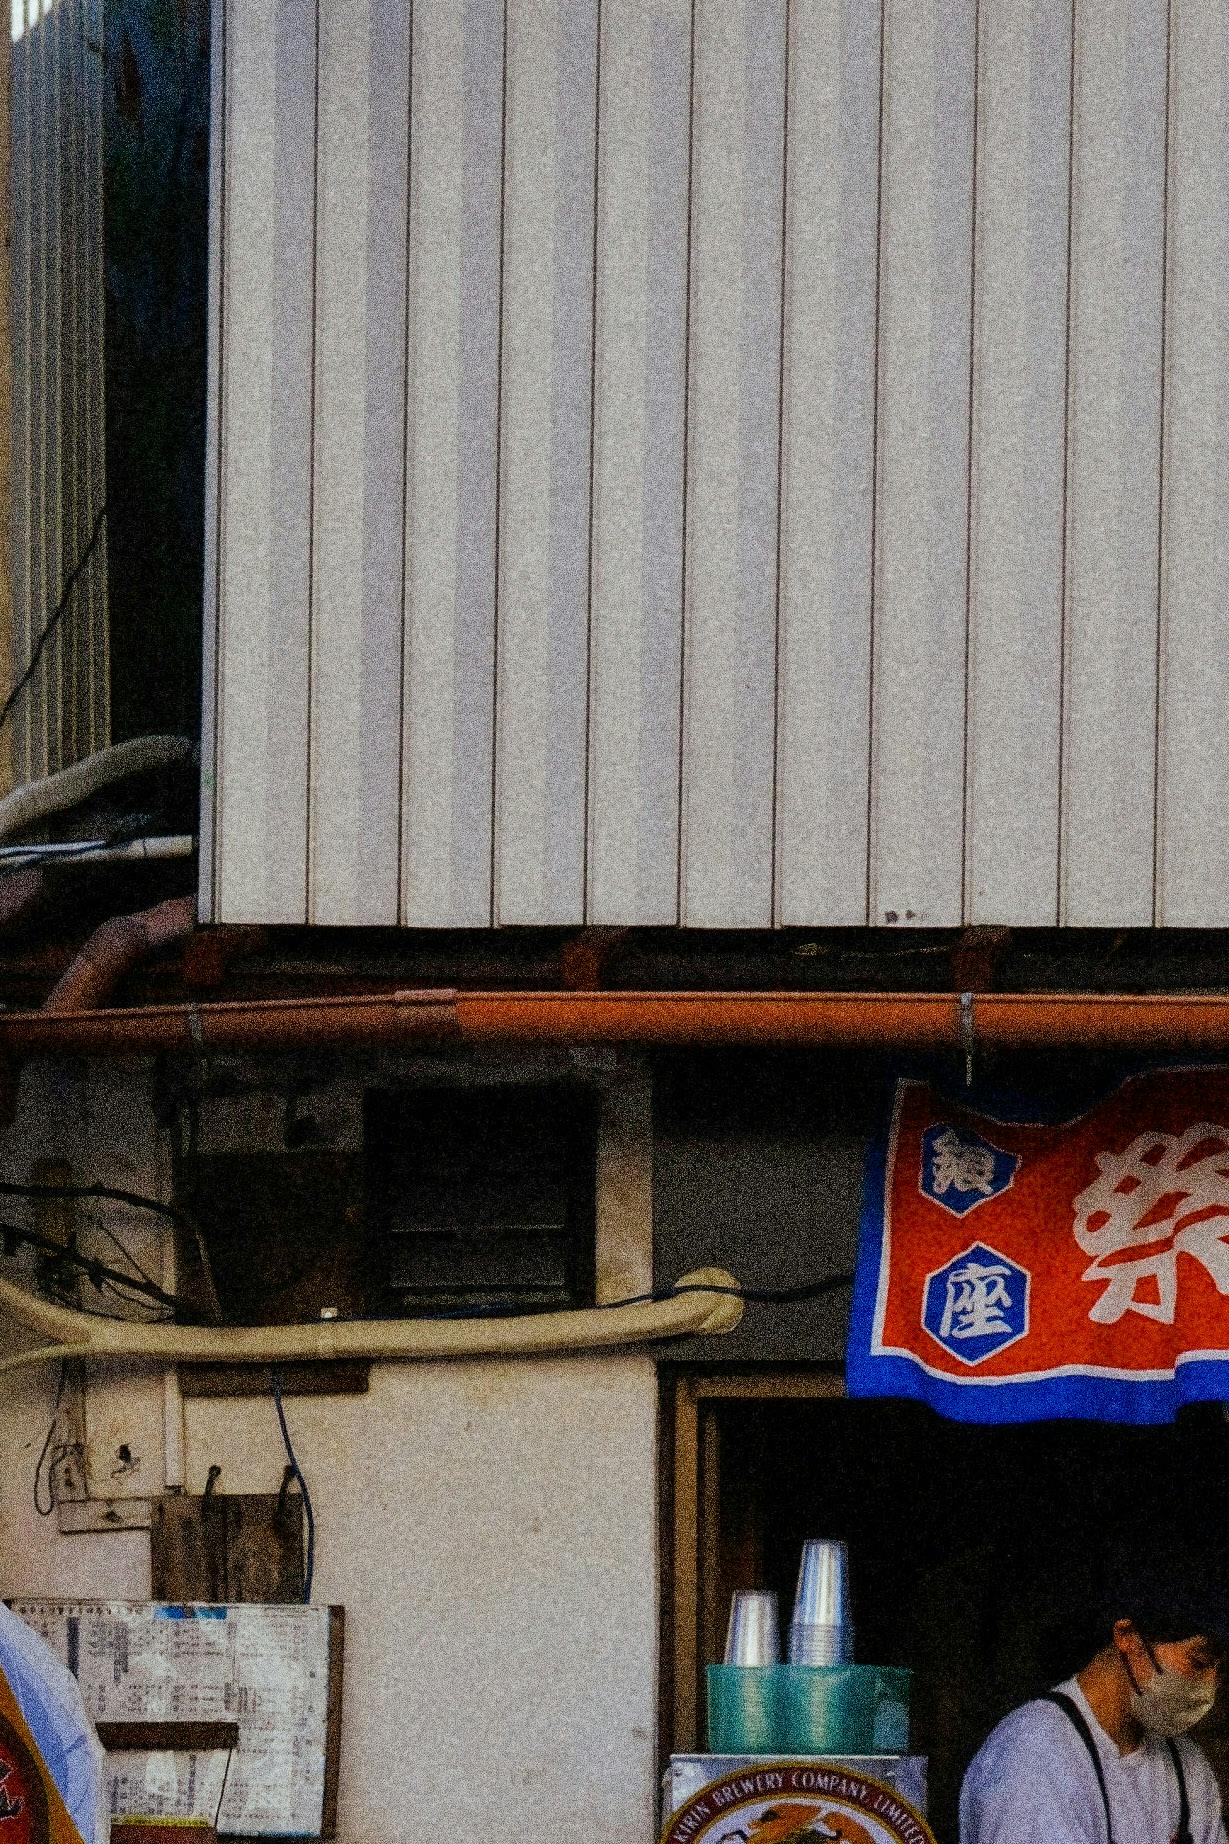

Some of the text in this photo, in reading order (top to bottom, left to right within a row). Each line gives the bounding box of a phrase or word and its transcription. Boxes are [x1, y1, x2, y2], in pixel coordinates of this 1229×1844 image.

[672, 1799, 714, 1844] KIRIN
[712, 1771, 785, 1809] BREWERY
[791, 1771, 871, 1804] COMPANY,
